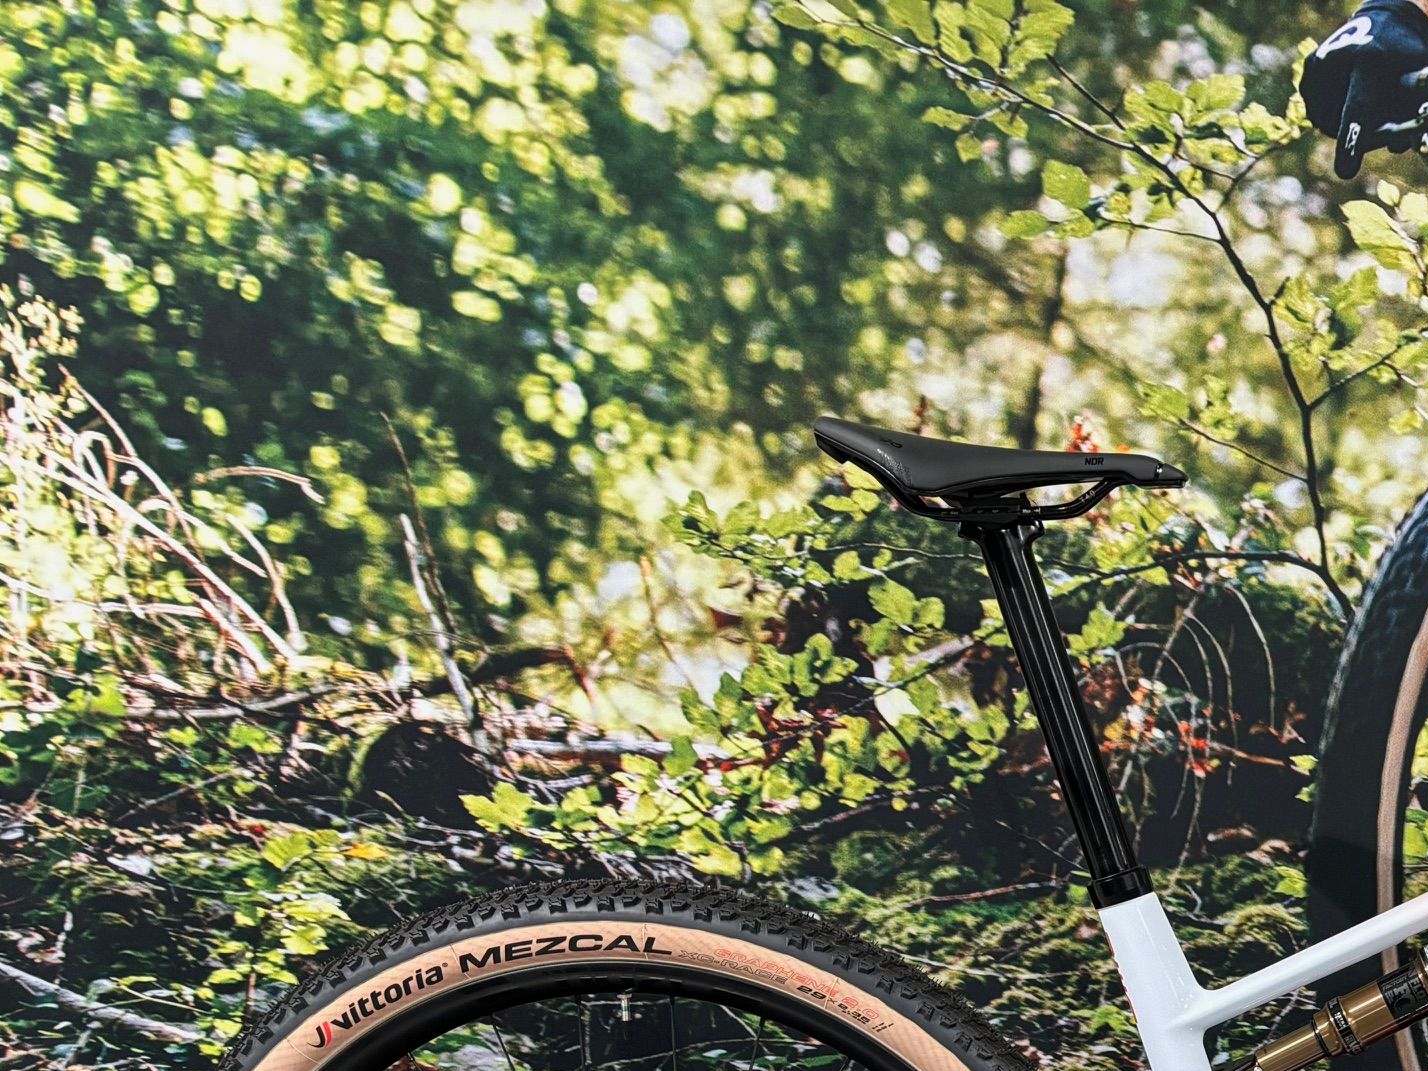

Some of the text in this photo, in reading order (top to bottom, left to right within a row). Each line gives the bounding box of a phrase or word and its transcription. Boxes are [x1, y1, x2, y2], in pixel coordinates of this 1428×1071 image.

[1084, 457, 1105, 466] NDR
[331, 934, 672, 1030] vittoria MEZCAL
[678, 949, 789, 986] XC-RACE
[712, 948, 839, 998] GRAPHENE
[841, 994, 880, 1020] 2.0
[796, 985, 827, 1000] 29
